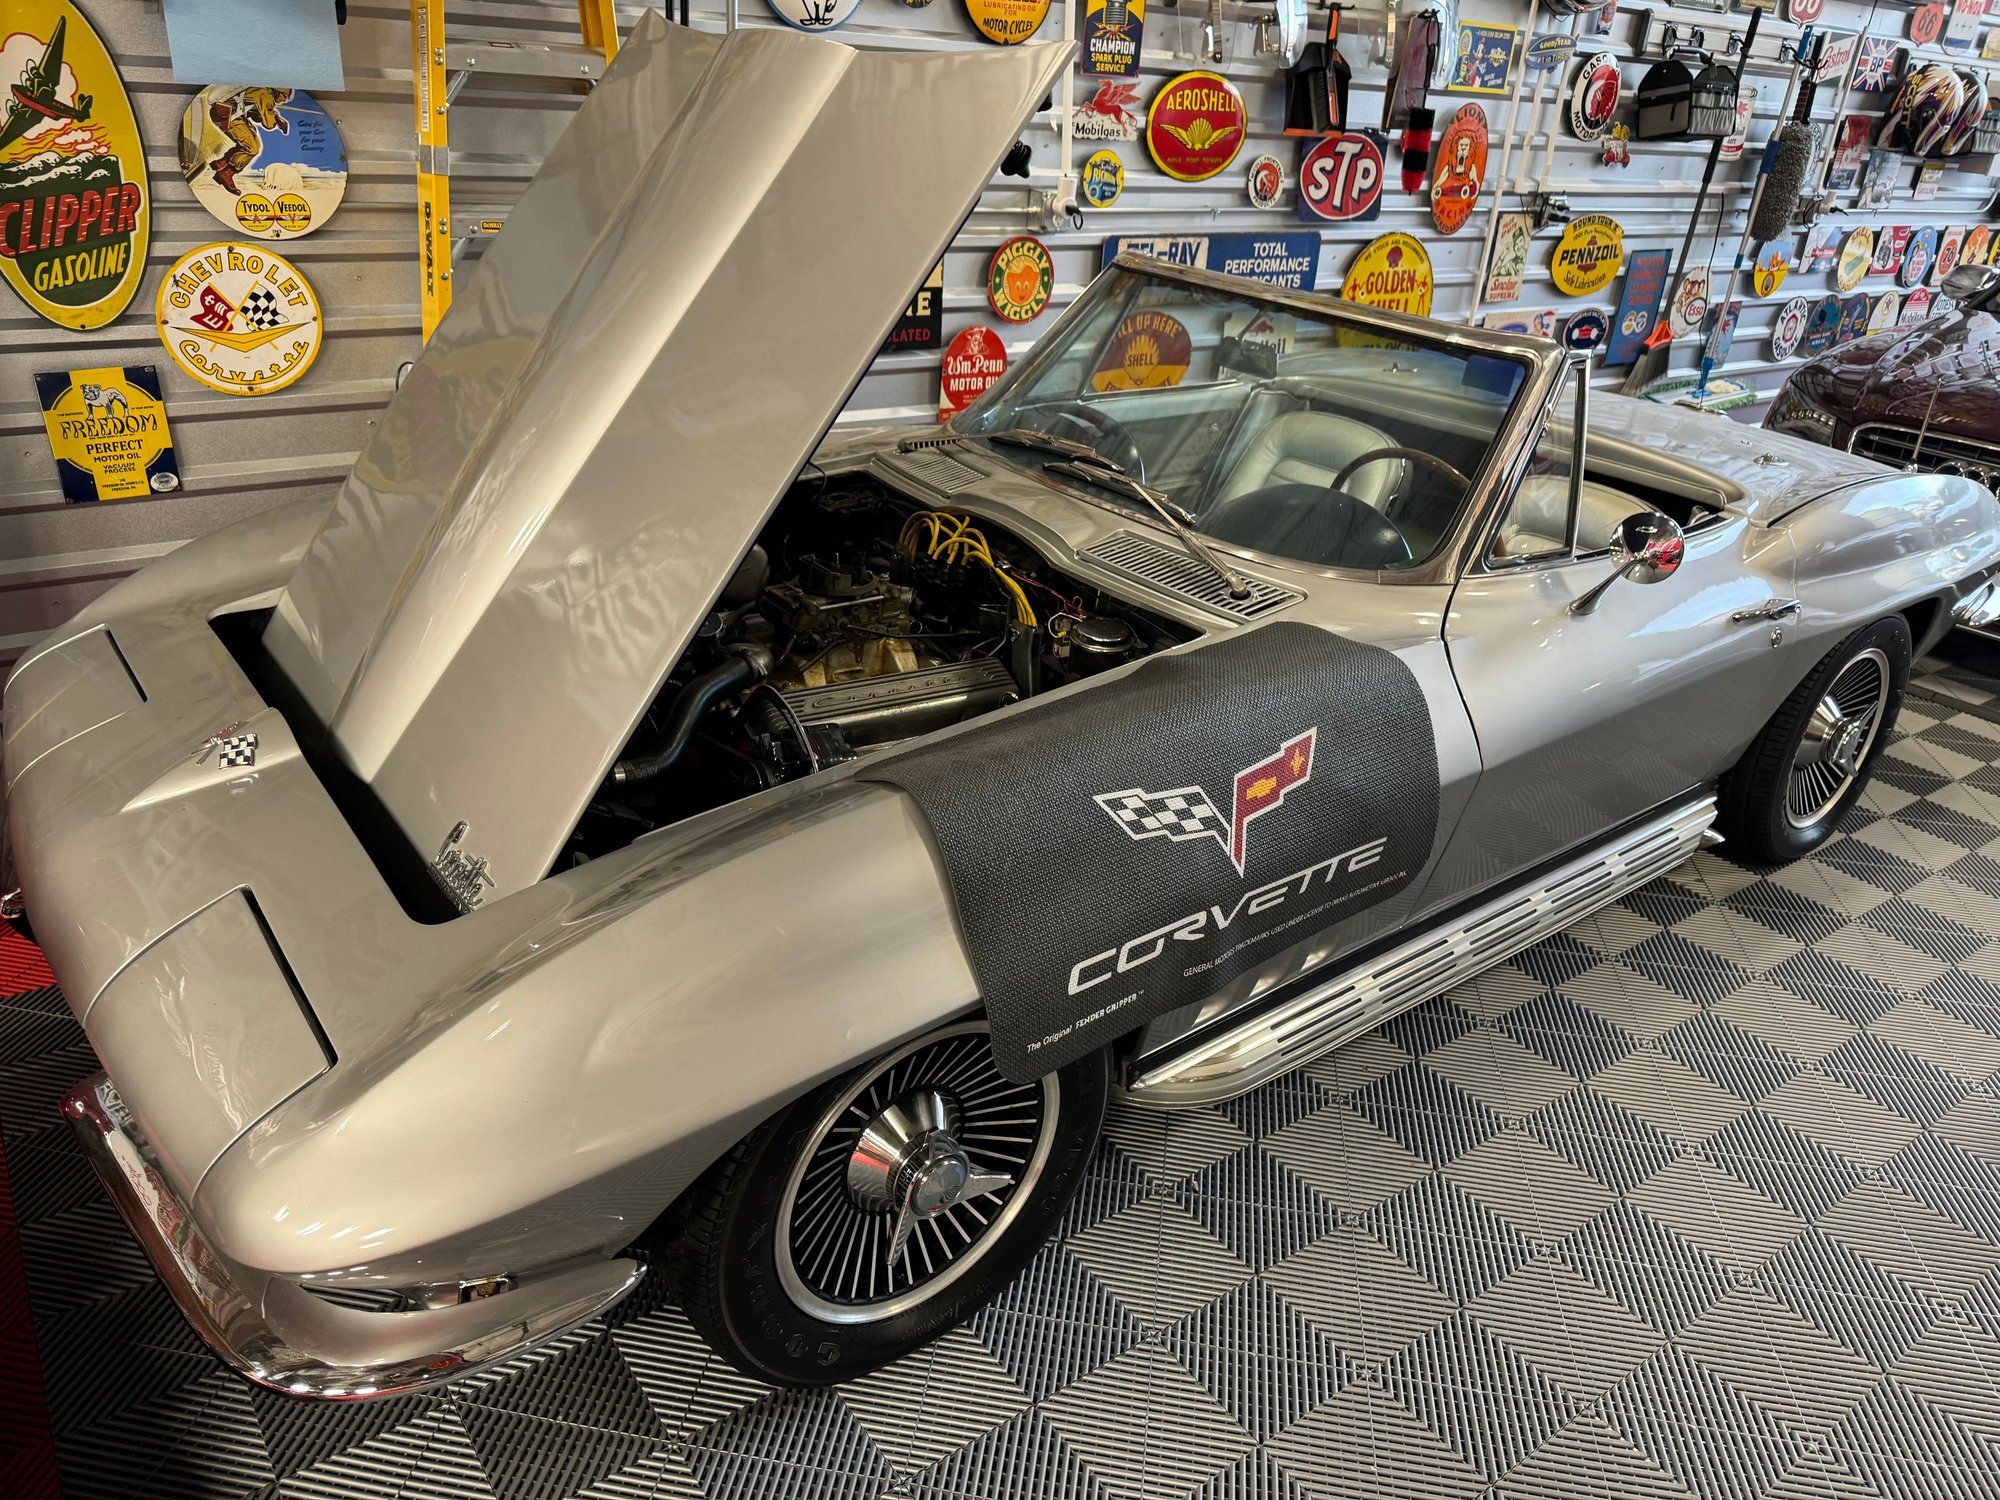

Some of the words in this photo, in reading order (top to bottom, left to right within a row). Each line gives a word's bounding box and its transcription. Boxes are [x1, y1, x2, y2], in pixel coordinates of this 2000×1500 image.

[984, 2, 1026, 11] LUBRICATING
[983, 18, 1008, 34] MOTOR
[1009, 20, 1033, 34] CYCLES
[1917, 9, 1937, 36] 66
[1090, 38, 1136, 55] CHAMPION
[1091, 52, 1112, 63] SPARK
[1114, 54, 1132, 64] PLUG
[1096, 62, 1125, 73] SERVICE
[1818, 39, 1855, 80] Castrol
[1870, 58, 1884, 72] BP
[1166, 88, 1236, 112] AEROSHELL
[1902, 74, 1922, 130] SCOTT
[1456, 107, 1484, 123] LION
[1574, 111, 1595, 140] MOTOR
[1075, 122, 1121, 138] Mobilgas
[1308, 141, 1378, 211] STP
[240, 200, 270, 214] TYDOL
[277, 201, 308, 214] VEEDOL
[1434, 198, 1472, 220] RACING
[0, 183, 140, 258] CLIPPER
[1572, 215, 1596, 232] SOUND
[1597, 215, 1613, 226] YOUR
[1851, 229, 1870, 244] SHELL
[998, 240, 1049, 270] PIGGLY
[1253, 242, 1288, 257] TOTAL
[1373, 242, 1388, 254] STOCK
[1402, 240, 1424, 264] RECOMMEND
[1558, 244, 1620, 267] PENNZOIL
[34, 242, 128, 292] GASOLINE
[1224, 257, 1310, 274] PERFORMANCE
[170, 252, 308, 310] CHEVROLET
[1365, 269, 1416, 295] GOLDEN
[1491, 278, 1518, 292] Sinclair
[1564, 270, 1575, 288] Safe
[1574, 272, 1606, 290] Lubrication
[992, 286, 1049, 322] WIGGLY
[1490, 291, 1516, 300] SUPREME
[1780, 300, 1806, 325] ATLANTIC
[1136, 315, 1151, 330] UP
[1152, 315, 1178, 338] HERE
[1774, 336, 1800, 358] GASOLINE
[179, 340, 310, 385] Corvette
[1127, 353, 1154, 367] SHELL
[950, 376, 983, 392] MOTOR
[60, 414, 158, 440] FREEDOM
[86, 439, 144, 455] PERFECT
[94, 454, 124, 463] MOTOR
[126, 452, 142, 460] OIL
[103, 462, 135, 470] VACUUM
[1068, 836, 1388, 996] CORVETTE
[1183, 961, 1214, 976] GENERAL
[1214, 946, 1235, 966] MOTORS
[1235, 930, 1270, 952] TRADEMARKS
[1270, 923, 1286, 935] USED
[1286, 914, 1304, 928] UNDER
[1304, 904, 1324, 920] LICENSE
[1026, 1041, 1041, 1054] The
[1043, 1025, 1072, 1046] Original
[1076, 1008, 1105, 1029] FENDER
[1106, 993, 1137, 1014] GRIPPER
